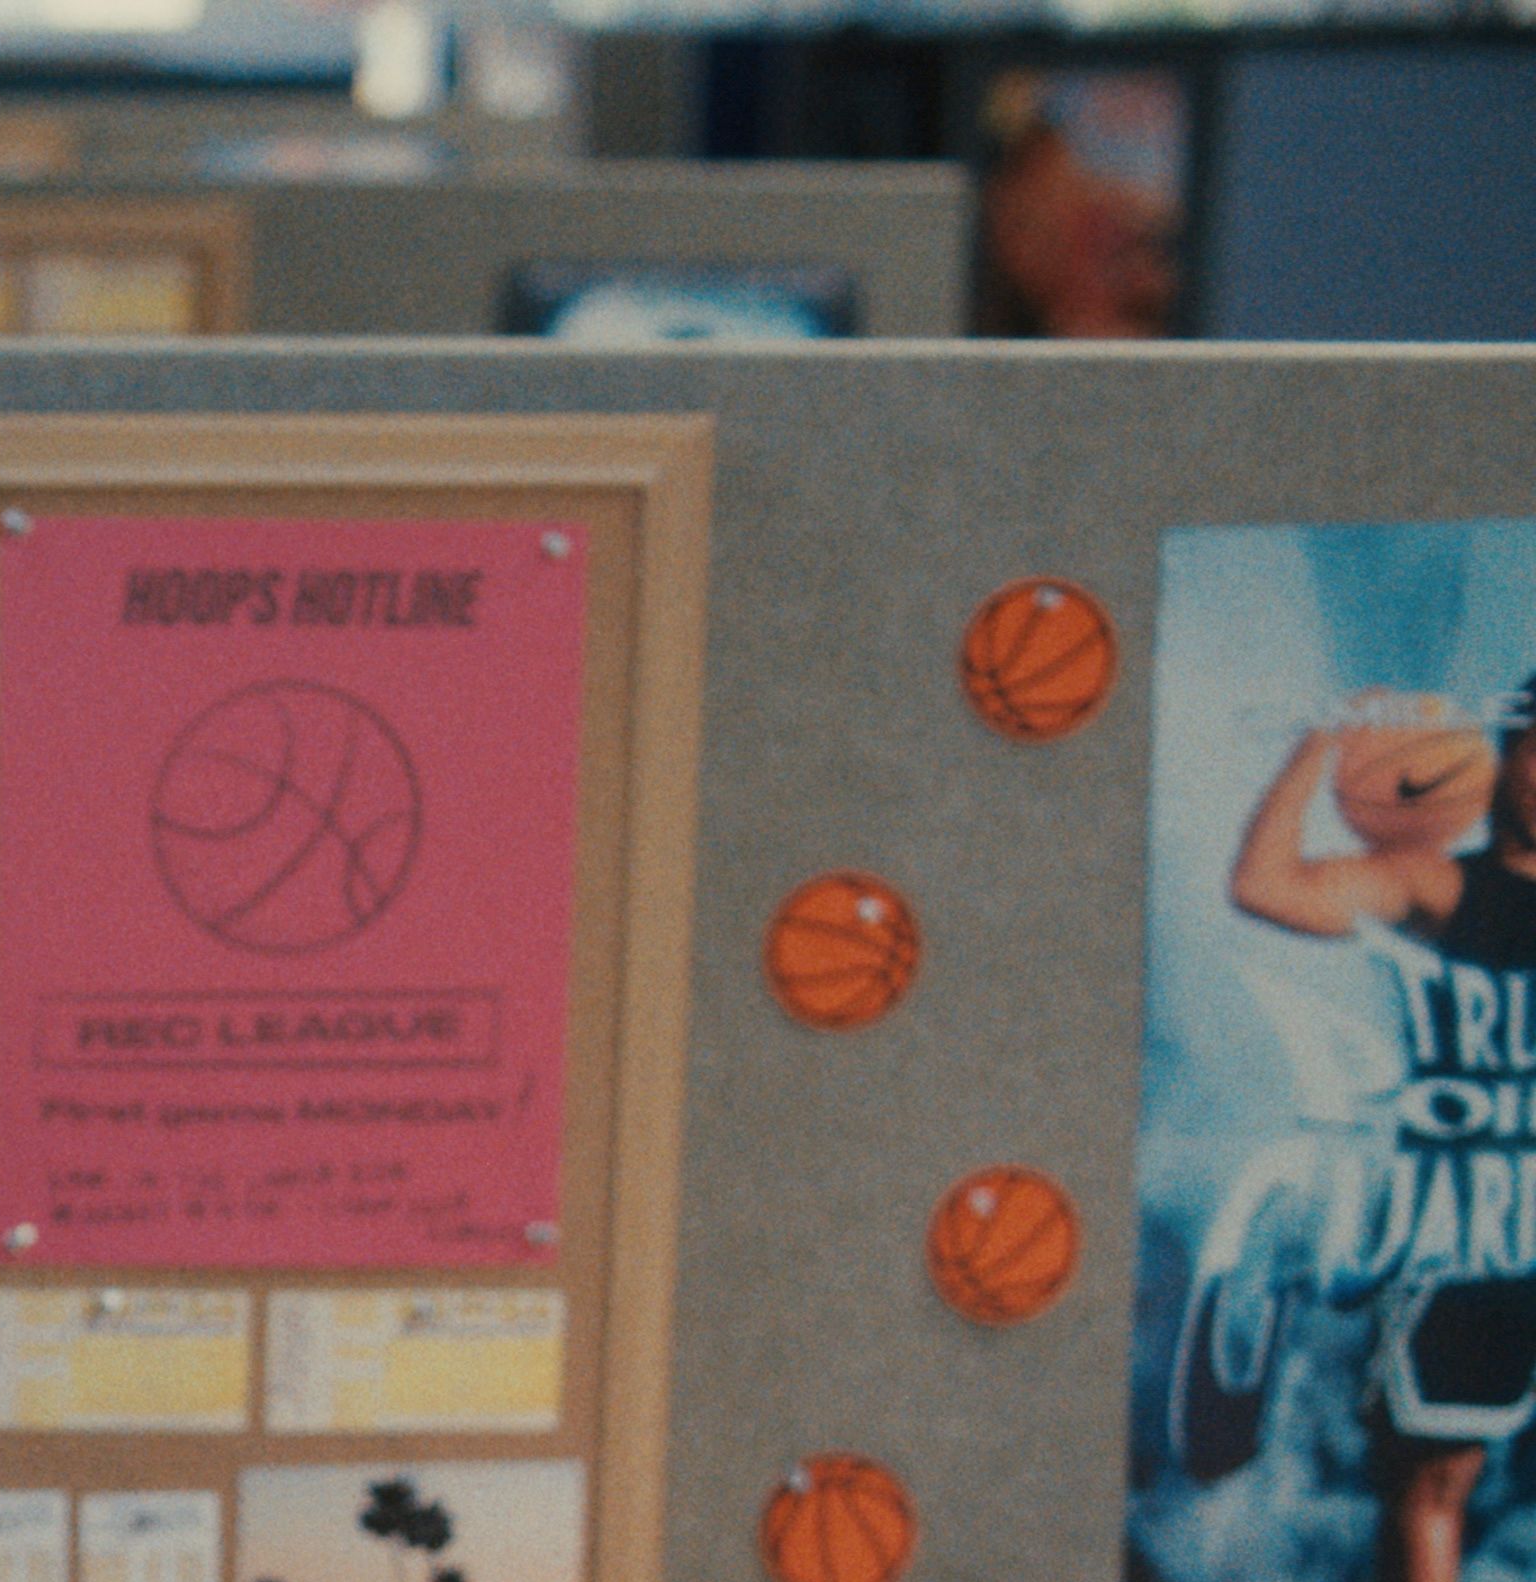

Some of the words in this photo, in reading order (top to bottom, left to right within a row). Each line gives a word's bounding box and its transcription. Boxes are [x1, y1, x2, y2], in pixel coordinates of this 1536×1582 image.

[120, 567, 285, 628] HOOPS
[290, 567, 485, 628] HOTLINE
[77, 1015, 203, 1050] REC
[217, 1006, 461, 1046] LEAGUE
